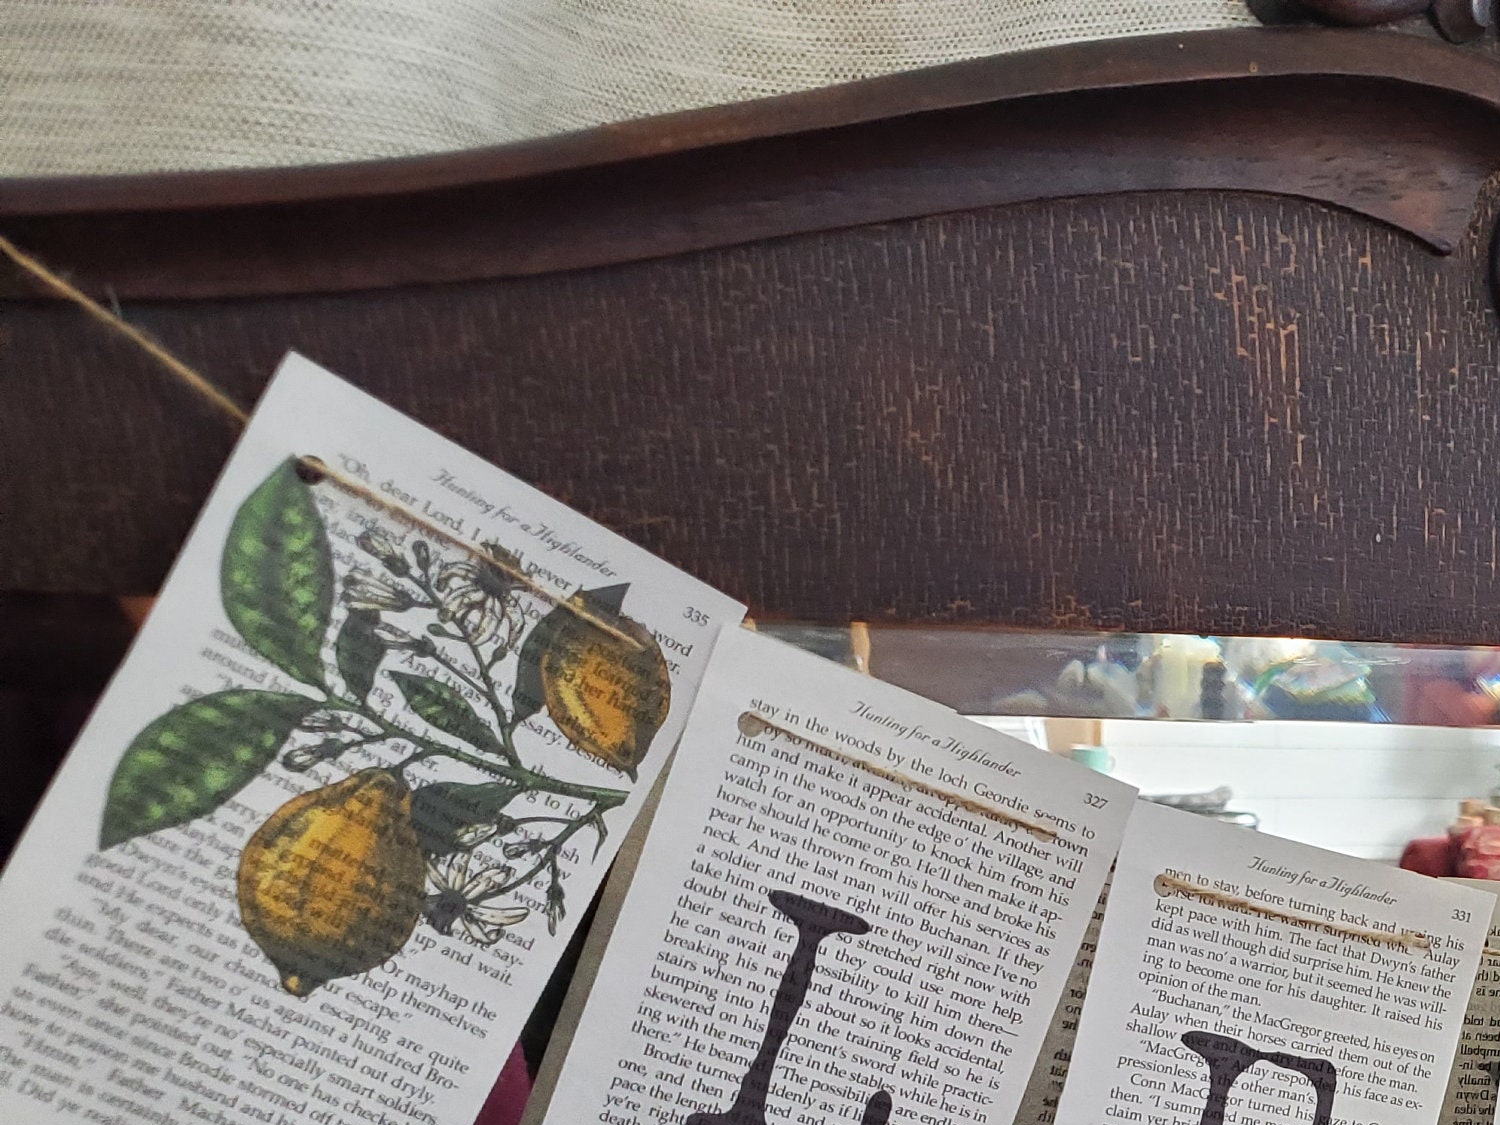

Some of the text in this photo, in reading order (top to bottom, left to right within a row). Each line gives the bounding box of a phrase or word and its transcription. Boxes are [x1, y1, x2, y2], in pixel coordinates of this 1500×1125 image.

[432, 474, 617, 578] Hunting for a Highlander
[683, 606, 711, 627] 335
[849, 700, 1022, 777] Hunting for a Highlander
[1083, 792, 1109, 810] 327
[725, 770, 1070, 907] watch for an opportunity to knock him from his
[1247, 857, 1398, 905] Hunting for a Highlander
[1155, 898, 1457, 983] kept pace with him. The fact that Dwyn's father
[1451, 908, 1471, 924] 331
